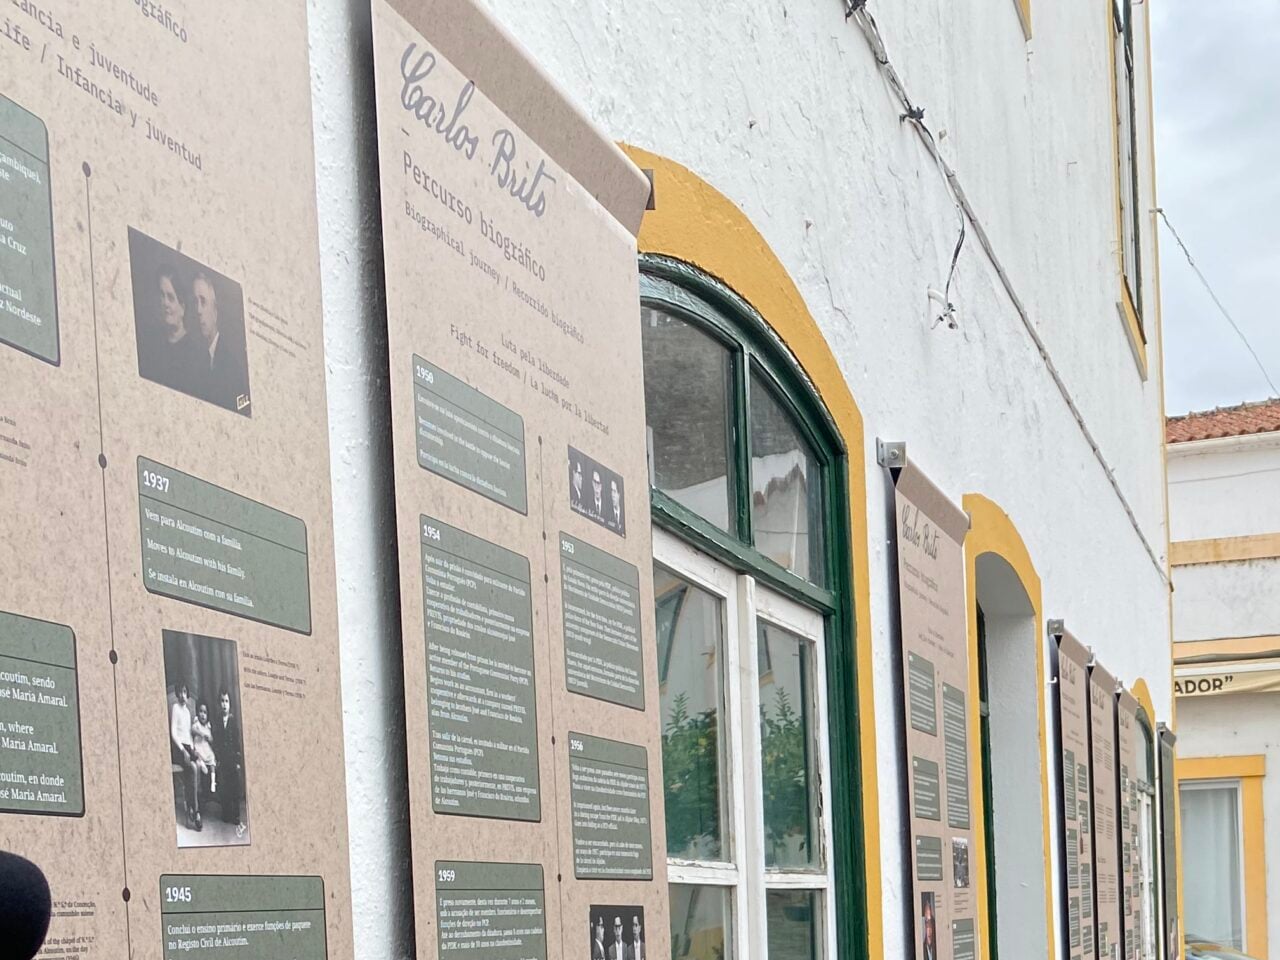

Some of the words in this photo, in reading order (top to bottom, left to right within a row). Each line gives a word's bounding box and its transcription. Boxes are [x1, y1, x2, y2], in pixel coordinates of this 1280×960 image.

[72, 34, 80, 50] e
[89, 43, 158, 107] juventude
[0, 18, 30, 50] ife
[57, 54, 123, 116] Infancia
[129, 109, 137, 128] y
[145, 117, 201, 170] juventud
[400, 42, 479, 160] Carlos
[491, 129, 557, 217] Brito
[403, 151, 472, 225] Percurso
[480, 210, 546, 282] biográfico
[405, 200, 465, 257] Biographical
[469, 250, 500, 290] journey
[512, 281, 549, 319] Recorrido
[551, 308, 584, 345] biográfico
[6, 299, 41, 326] Nordeste
[501, 332, 517, 354] Luta
[520, 348, 535, 367] pela
[538, 358, 570, 389] liberdade
[416, 364, 434, 384] 1950
[450, 323, 472, 349] Fight
[476, 340, 489, 359] for
[492, 351, 520, 379] freedom
[530, 376, 538, 391] La
[541, 382, 559, 403] lucha
[561, 398, 572, 412] por
[574, 403, 582, 418] la
[584, 410, 609, 435] libertad
[143, 469, 170, 493] 1937
[145, 508, 159, 522] Vem
[160, 516, 175, 530] para
[176, 518, 202, 536] Alcoutim
[203, 530, 216, 541] com
[216, 534, 220, 542] a
[424, 524, 441, 541] 1954
[146, 538, 166, 554] Moves
[168, 545, 174, 556] to
[176, 547, 202, 565] Alcoutim
[203, 556, 216, 569] with
[217, 560, 226, 572] his
[148, 568, 156, 580] Se
[157, 570, 177, 586] instala
[179, 579, 186, 588] en
[187, 579, 213, 595] Alcoutim
[215, 589, 225, 599] con
[226, 592, 232, 601] su
[31, 674, 54, 688] sendo
[12, 688, 35, 701] Maria
[37, 692, 67, 706] Amaral.
[8, 721, 33, 734] where
[1, 737, 25, 749] Maria
[27, 740, 57, 753] Amaral.
[28, 776, 38, 784] en
[39, 774, 64, 786] donde
[11, 788, 34, 800] Maria
[36, 790, 66, 802] Amaral.
[438, 869, 456, 882] 1959
[166, 886, 191, 901] 1945
[167, 924, 190, 934] Conclui
[196, 923, 215, 933] ensino
[217, 922, 241, 934] primário
[264, 921, 284, 932] funções
[284, 921, 290, 929] de
[168, 941, 176, 949] no
[177, 938, 199, 951] Registo
[200, 937, 213, 947] Civil
[214, 937, 221, 946] de
[222, 935, 248, 946] Alcoutim.
